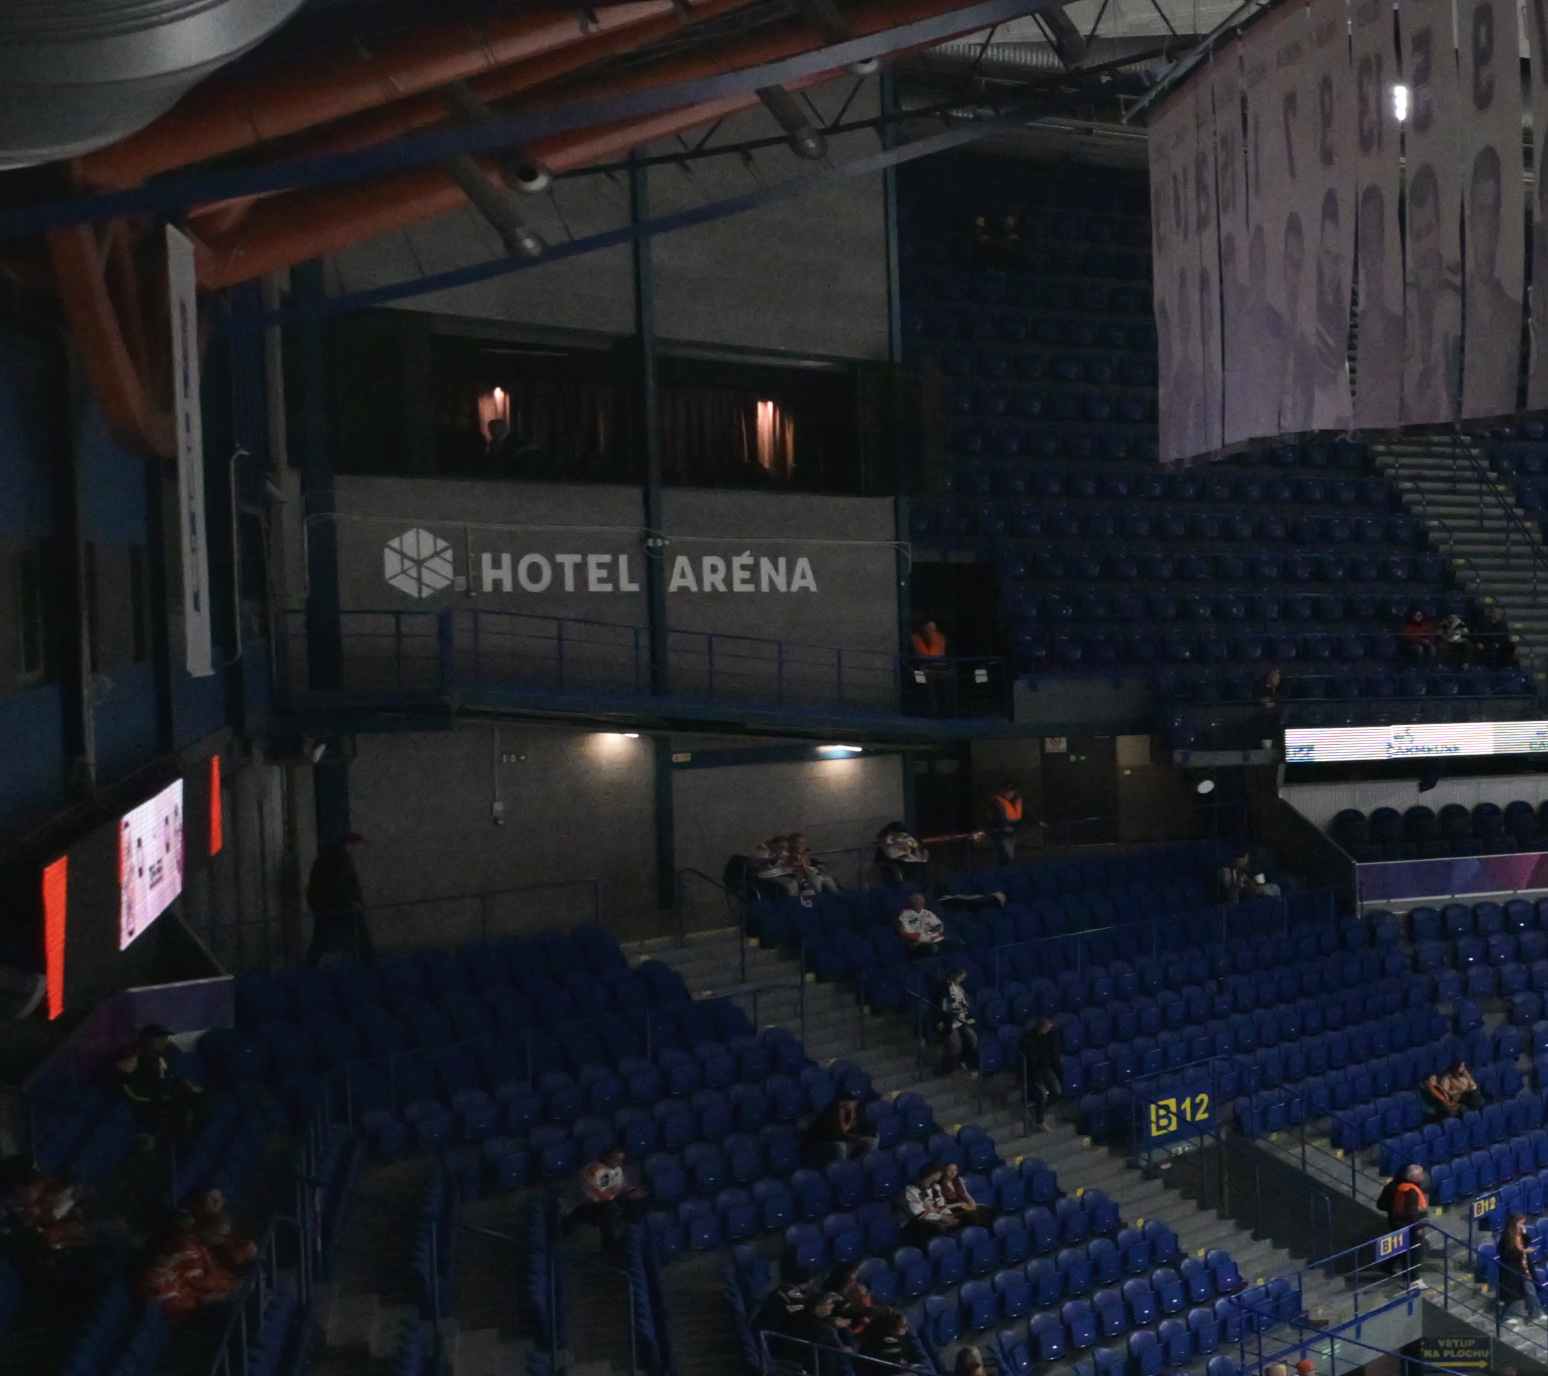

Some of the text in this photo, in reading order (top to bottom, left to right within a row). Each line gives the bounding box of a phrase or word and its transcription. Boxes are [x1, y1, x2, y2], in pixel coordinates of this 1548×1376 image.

[480, 549, 817, 593] HOTEL ARÉNA
[1424, 1349, 1438, 1359] NA
